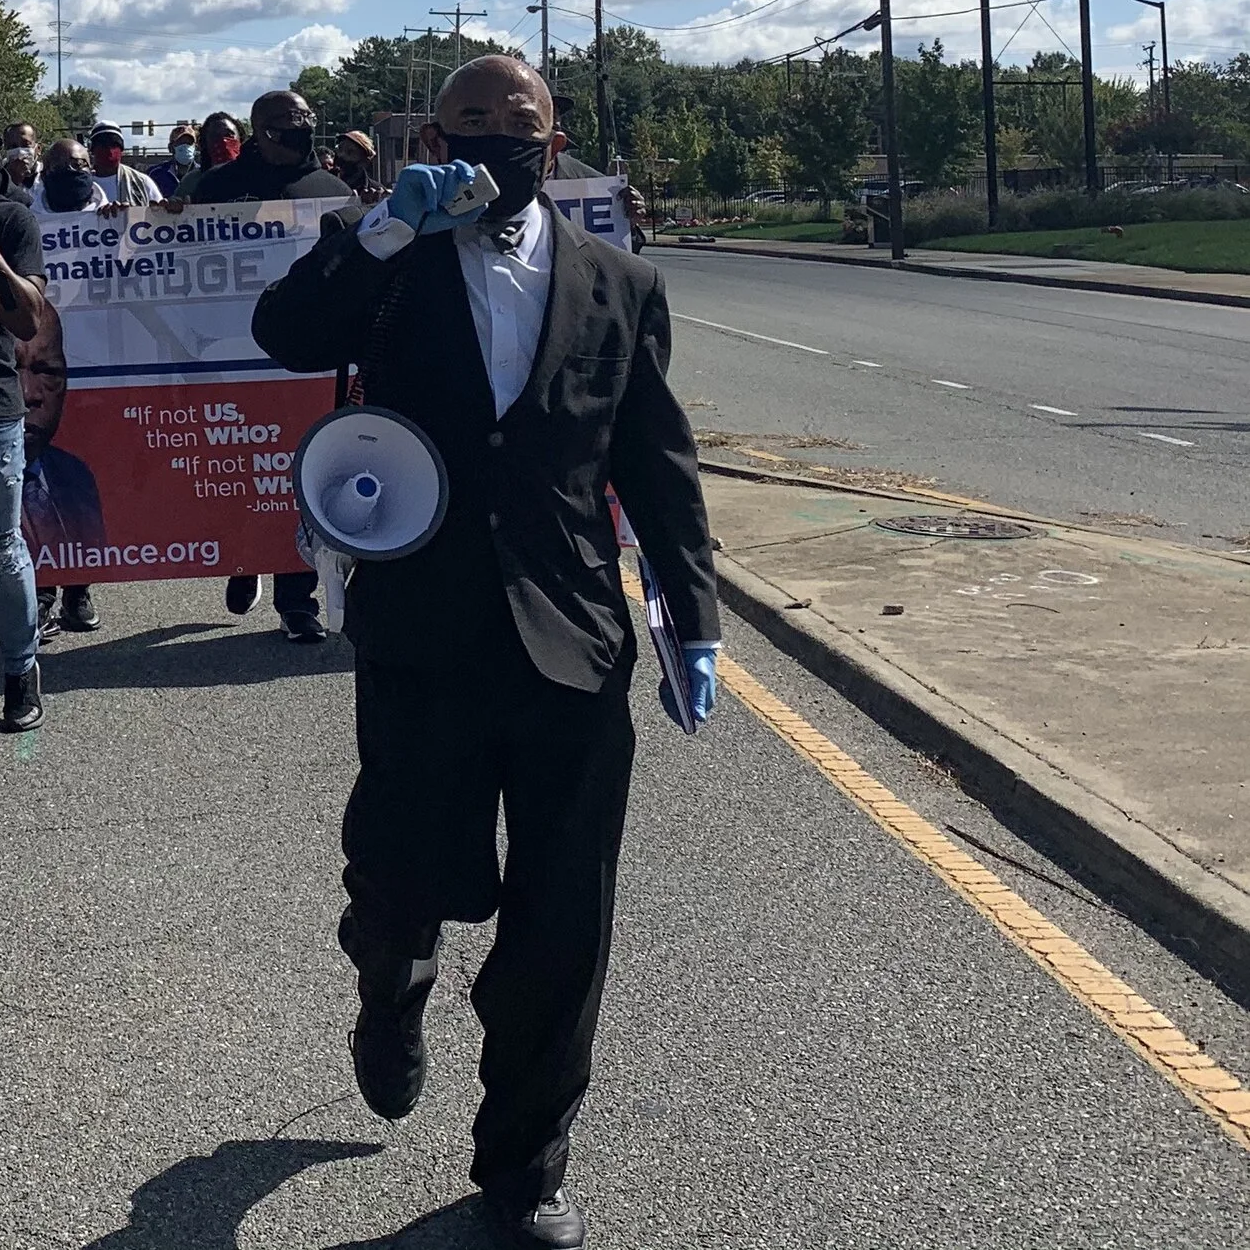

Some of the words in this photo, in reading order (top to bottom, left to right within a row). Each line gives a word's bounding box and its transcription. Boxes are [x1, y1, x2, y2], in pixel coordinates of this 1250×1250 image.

[554, 196, 614, 233] TE
[42, 224, 119, 251] stice
[129, 216, 286, 246] Coalition
[45, 251, 177, 281] mative!!
[159, 405, 198, 425] not
[203, 402, 246, 425] US,
[145, 428, 198, 449] then
[203, 423, 282, 446] WHO?
[207, 454, 247, 474] not
[252, 451, 296, 473] NO
[193, 478, 246, 498] then
[252, 475, 294, 495] WH
[246, 499, 289, 512] -John
